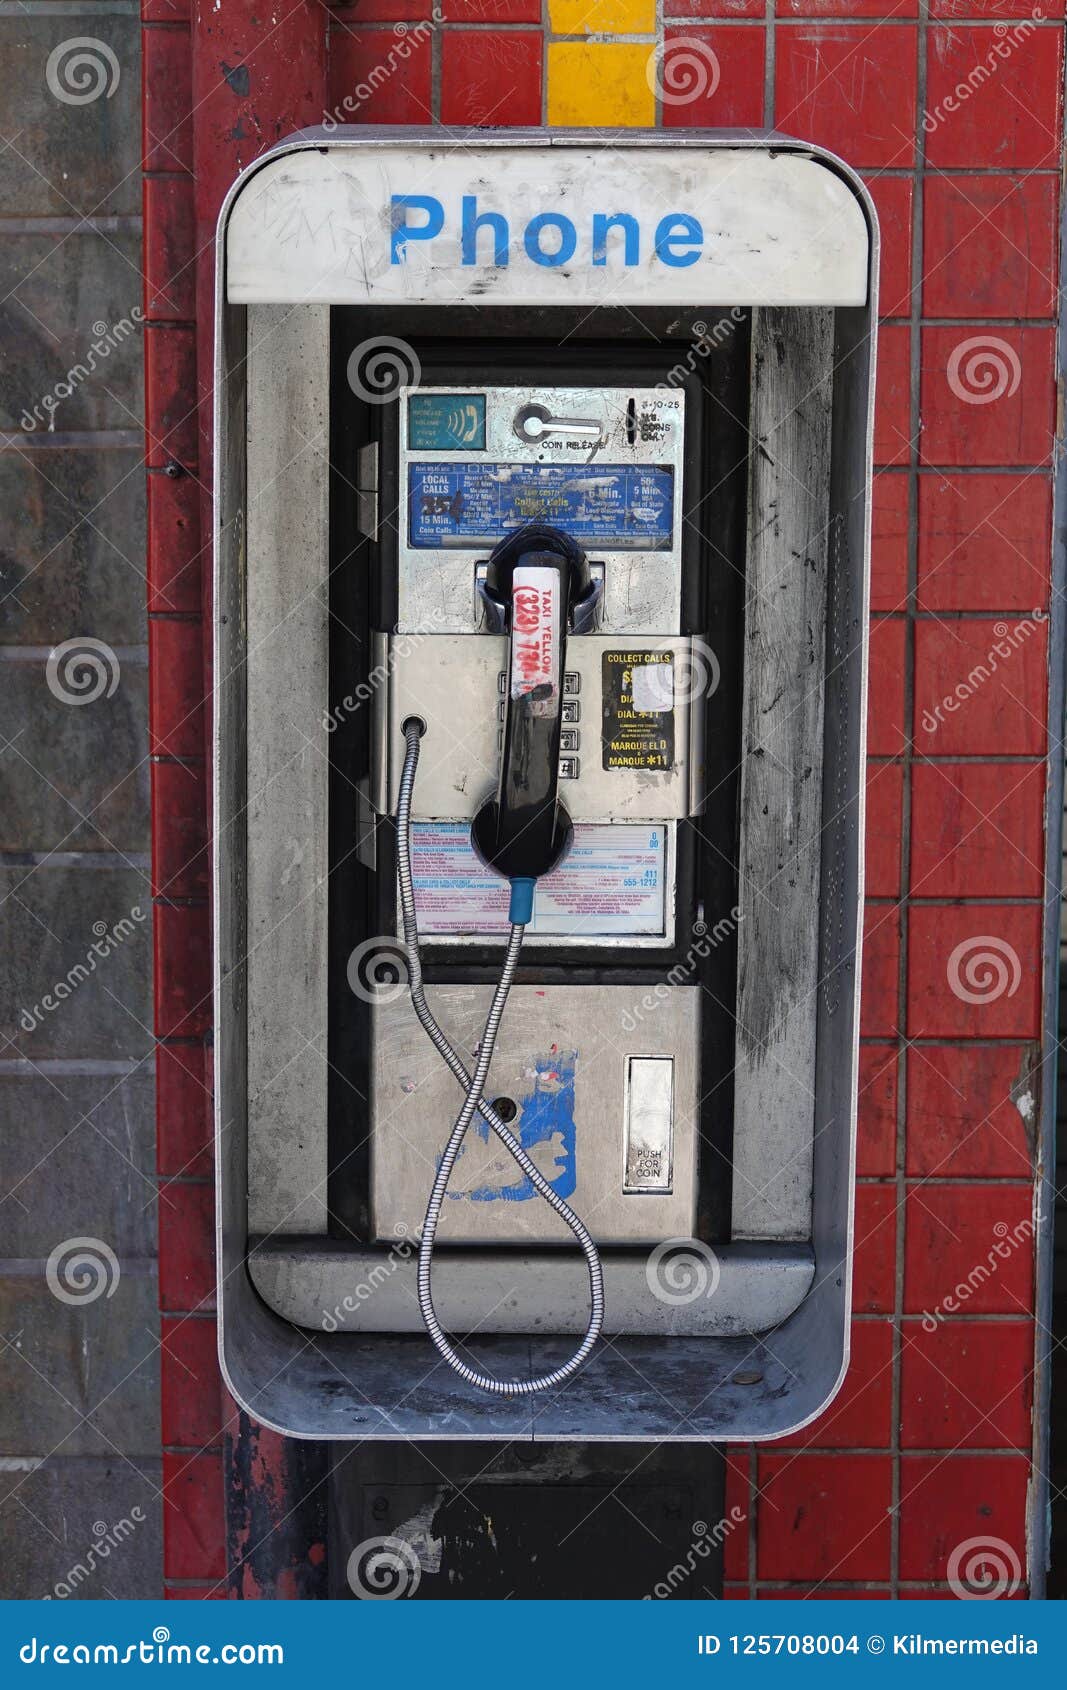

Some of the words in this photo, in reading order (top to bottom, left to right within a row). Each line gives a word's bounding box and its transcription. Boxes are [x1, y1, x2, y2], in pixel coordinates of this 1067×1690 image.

[390, 195, 704, 267] Phone
[541, 441, 563, 449] COIN
[422, 475, 449, 484] LOCAL
[423, 485, 449, 494] CALLS
[599, 487, 622, 498] Min.
[421, 516, 431, 525] 15
[432, 516, 452, 525] Min.
[542, 590, 552, 618] TAXI
[513, 586, 540, 635] (323)
[541, 625, 552, 675] YELLOW
[607, 654, 643, 663] COLLECT
[644, 654, 670, 663] CALLS
[621, 695, 634, 704] DIA
[617, 710, 637, 719] DIAL
[611, 742, 647, 750] MARQUE
[648, 742, 659, 750] EL
[609, 757, 645, 766] MARQUE
[645, 870, 657, 878] 411
[623, 879, 657, 887] 555-1212
[637, 1150, 662, 1158] PUSH
[640, 1160, 659, 1168] FOR
[636, 1169, 660, 1177] COIN
